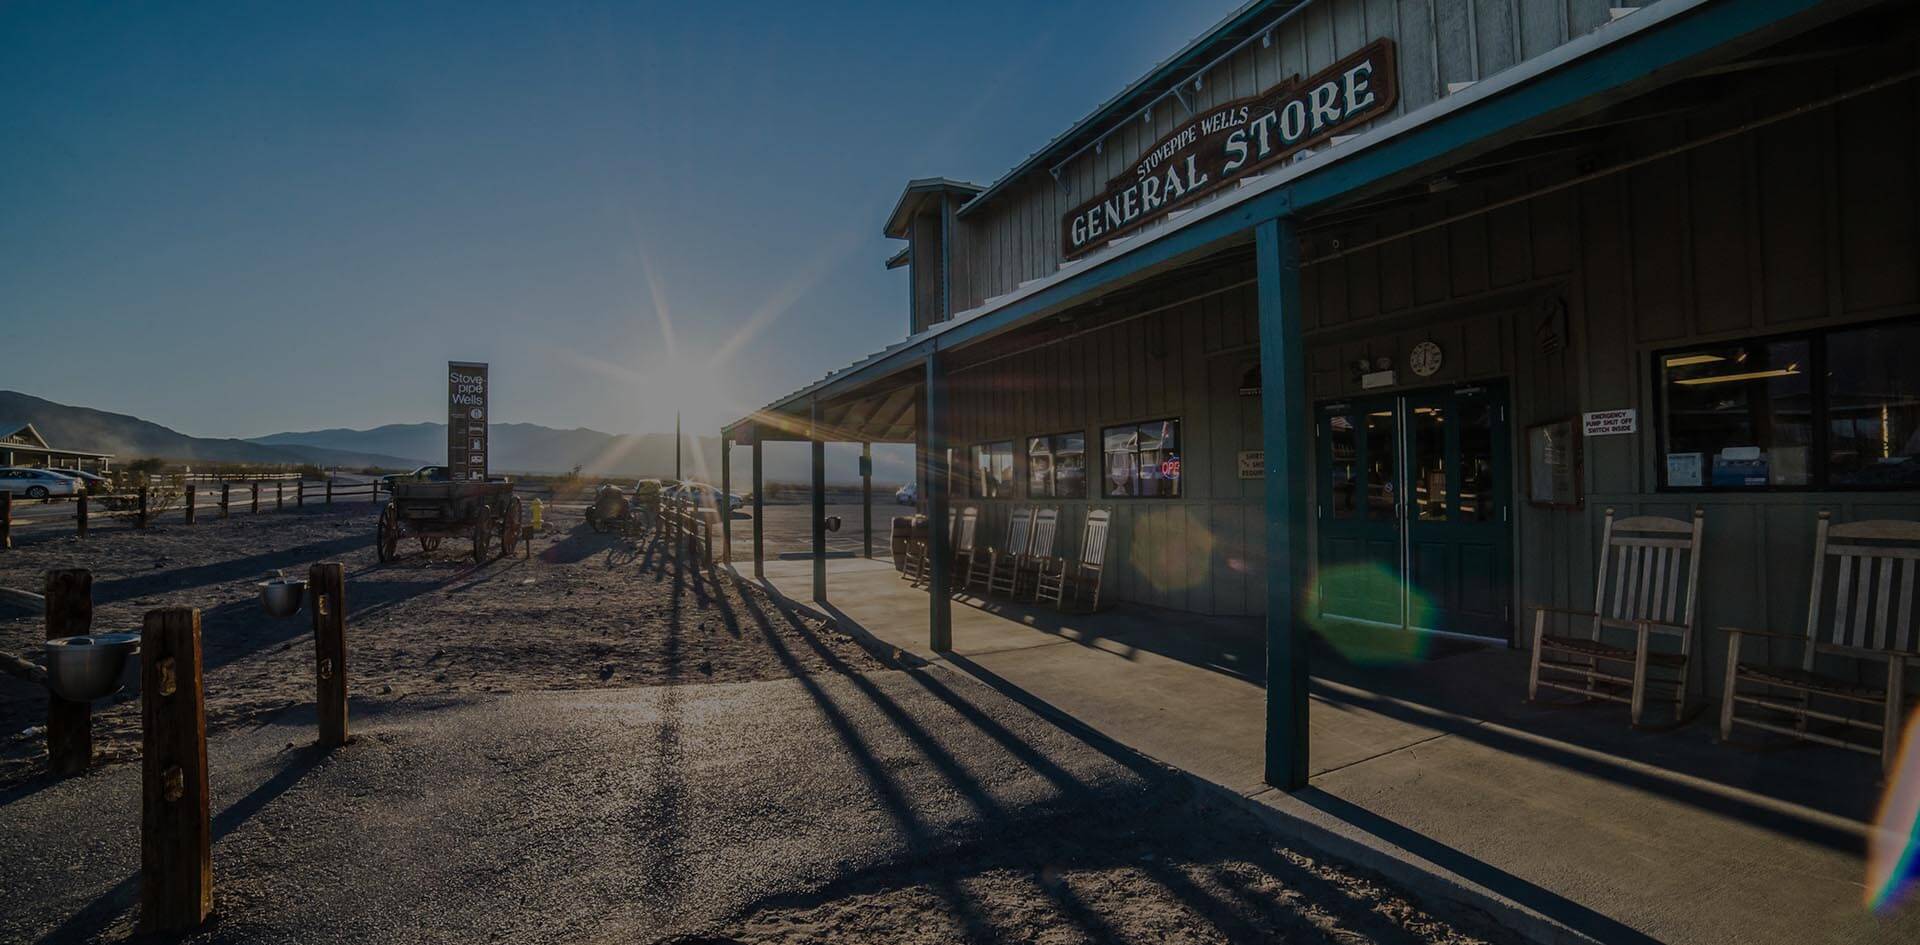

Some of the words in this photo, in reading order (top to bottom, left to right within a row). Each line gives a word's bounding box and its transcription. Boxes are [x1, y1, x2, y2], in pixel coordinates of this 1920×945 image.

[1136, 124, 1197, 181] STOVEPIPE
[1200, 106, 1249, 137] WELLS
[1071, 153, 1208, 249] GENERAL
[1221, 58, 1376, 174] STORE
[450, 372, 483, 384] Stove
[458, 383, 483, 394] pipe
[452, 393, 483, 406] Wells
[1591, 412, 1627, 420] EMERGENCY
[1588, 426, 1610, 434] SWITCH
[1162, 461, 1180, 474] OPE
